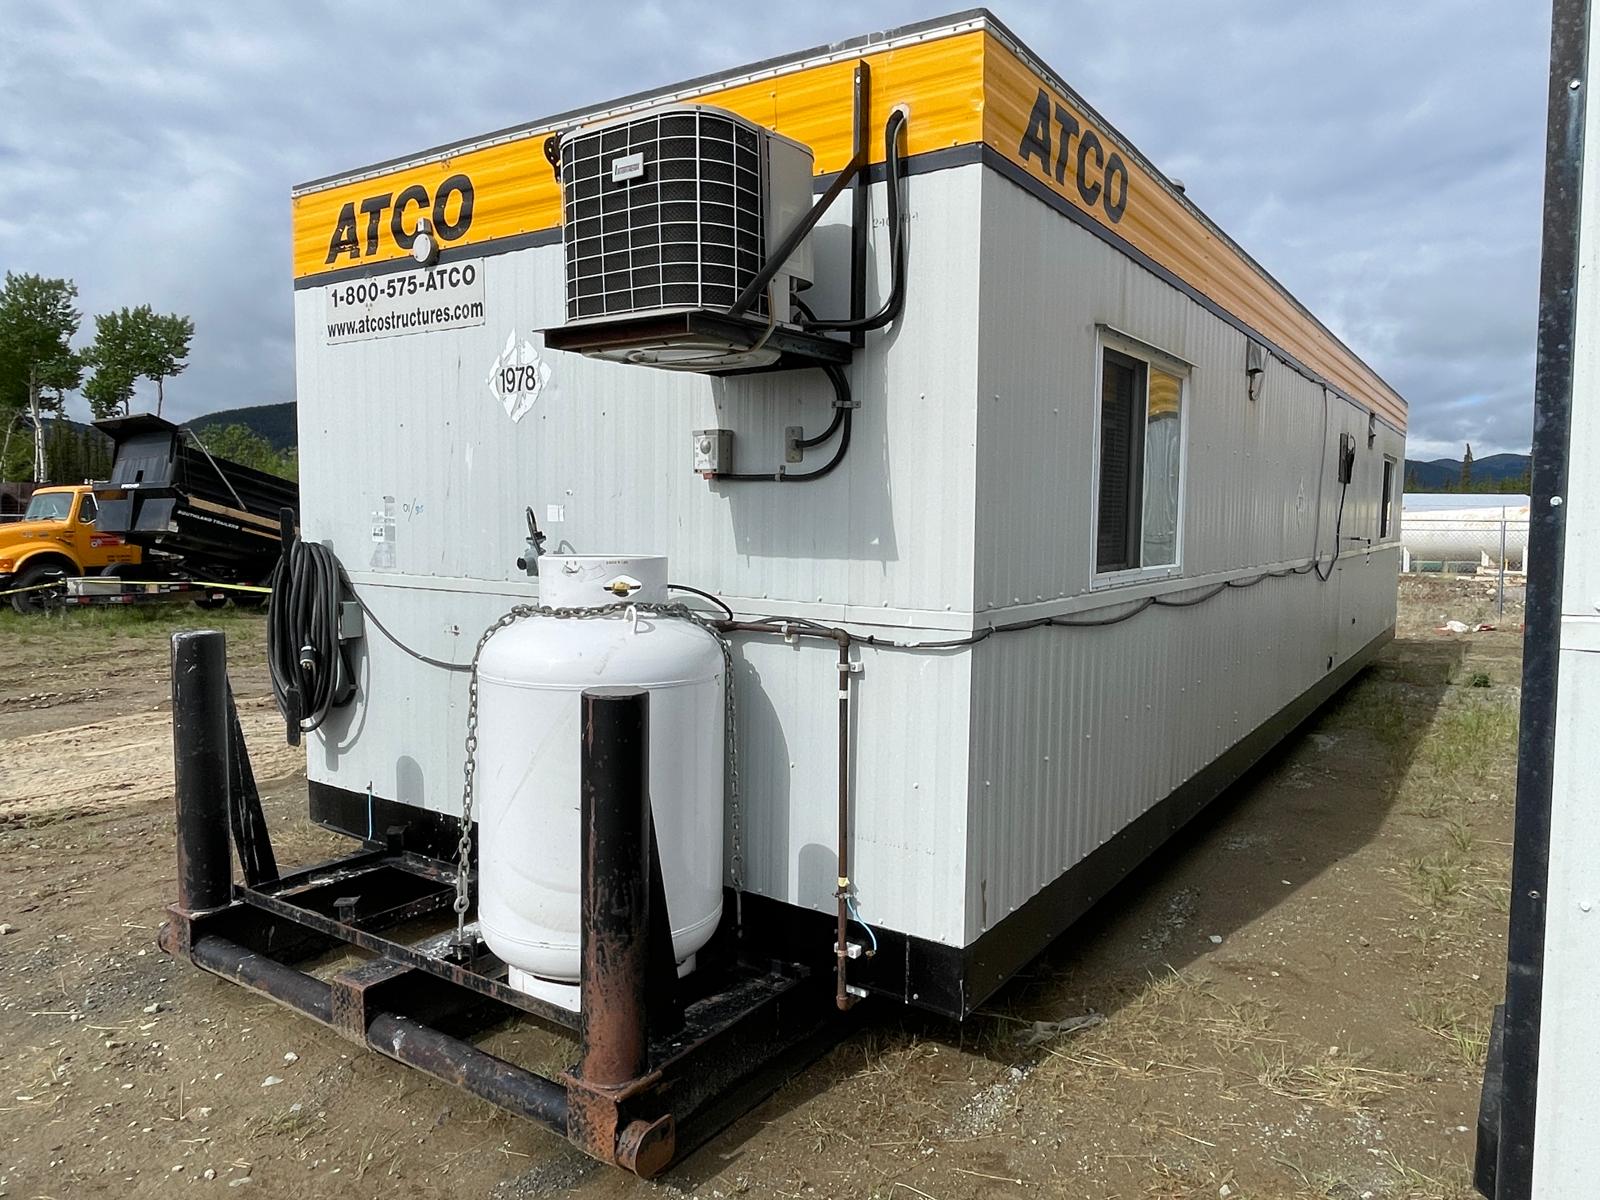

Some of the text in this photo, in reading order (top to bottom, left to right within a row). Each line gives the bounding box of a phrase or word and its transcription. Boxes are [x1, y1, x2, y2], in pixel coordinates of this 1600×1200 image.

[1018, 87, 1129, 224] ATCO
[324, 173, 475, 265] ATCO
[331, 264, 476, 308] 1-800-575-ATCO
[327, 301, 484, 338] www.atcostructures.com
[499, 365, 536, 393] 1978
